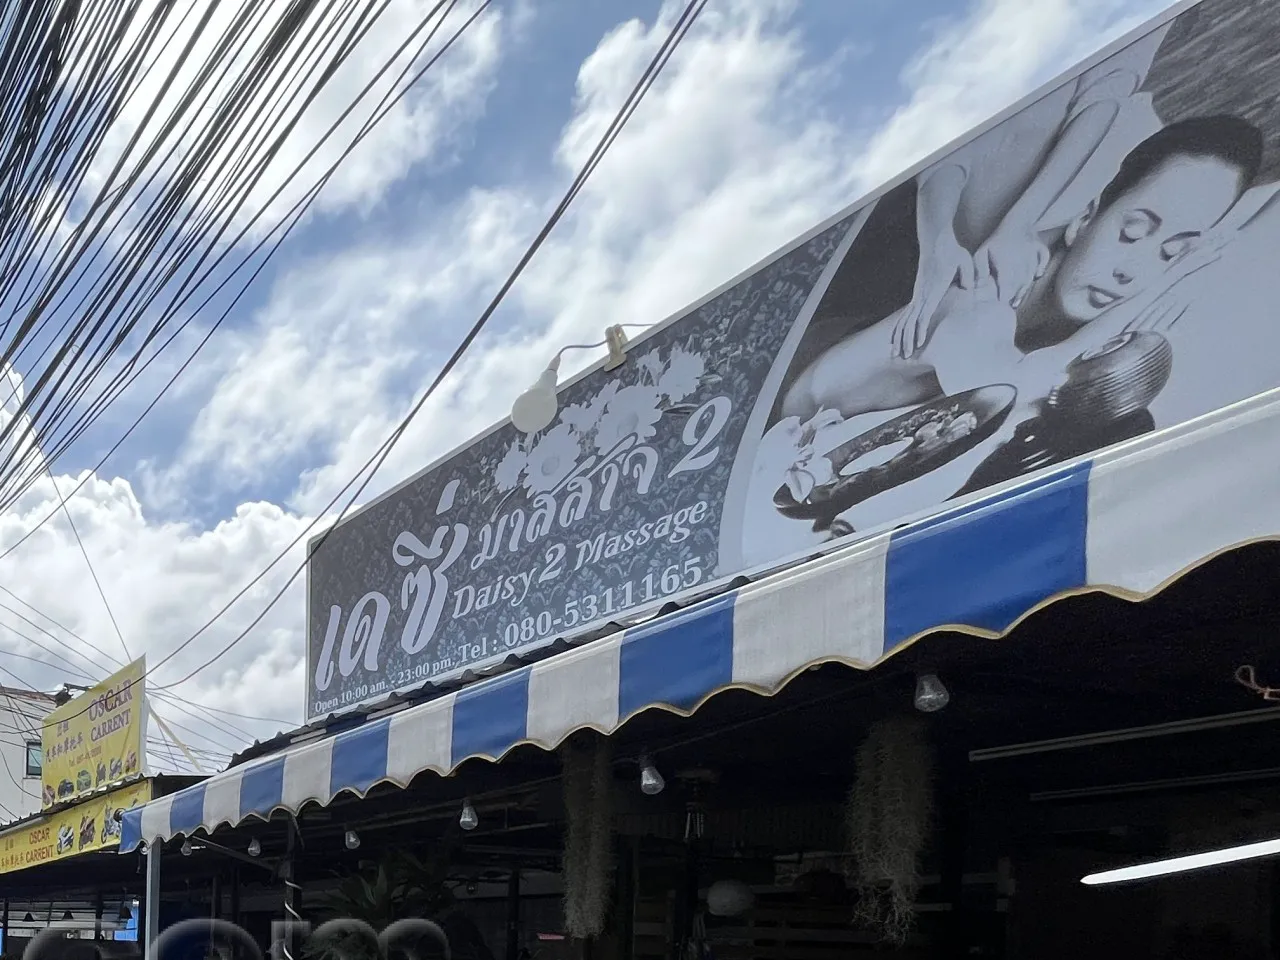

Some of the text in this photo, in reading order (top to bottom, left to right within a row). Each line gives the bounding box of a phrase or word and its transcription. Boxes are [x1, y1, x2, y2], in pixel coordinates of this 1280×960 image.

[667, 396, 732, 478] 2
[574, 500, 708, 572] Massage
[315, 480, 468, 691] เดซี่
[504, 556, 702, 647] 080-5311165
[88, 679, 133, 721] OSCAR
[314, 696, 339, 713] Open
[341, 685, 368, 704] 10:00
[397, 663, 430, 684] 23:00
[90, 708, 131, 742] CARRENT
[25, 844, 54, 864] CARRENT
[29, 827, 50, 845] OSCAR
